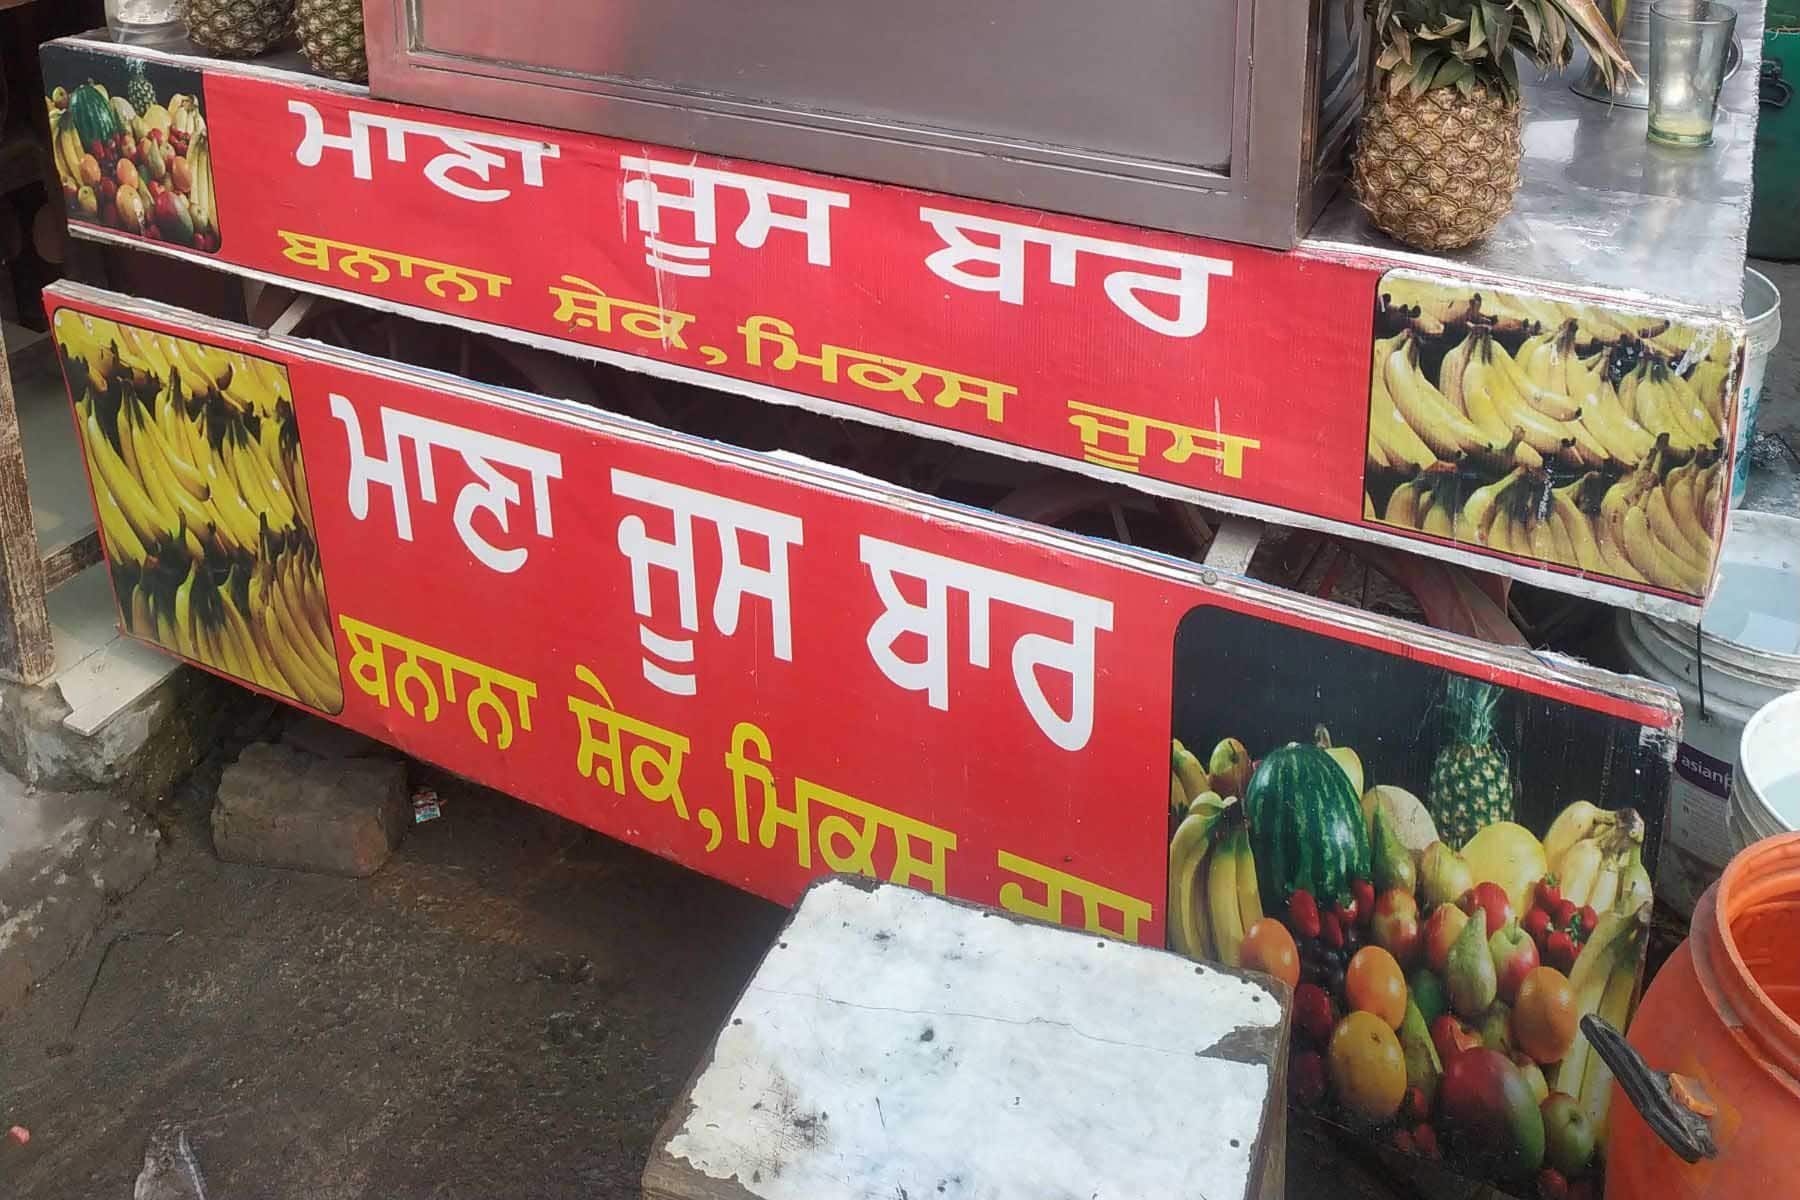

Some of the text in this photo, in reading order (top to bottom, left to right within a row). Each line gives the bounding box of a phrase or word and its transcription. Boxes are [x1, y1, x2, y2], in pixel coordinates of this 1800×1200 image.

[288, 100, 1233, 337] ਮਾਣਾ ਜੂਸ ਬਾਰ
[279, 230, 512, 301] ਬਨਾਨਾ
[738, 315, 1017, 422] ਮਿਕਸ
[1067, 400, 1260, 478] ਜੂਸ
[329, 393, 1114, 751] ਮਾਣਾ ਜੂਸ ਬਾਰ
[339, 614, 538, 749] ਬਨਾਨਾ
